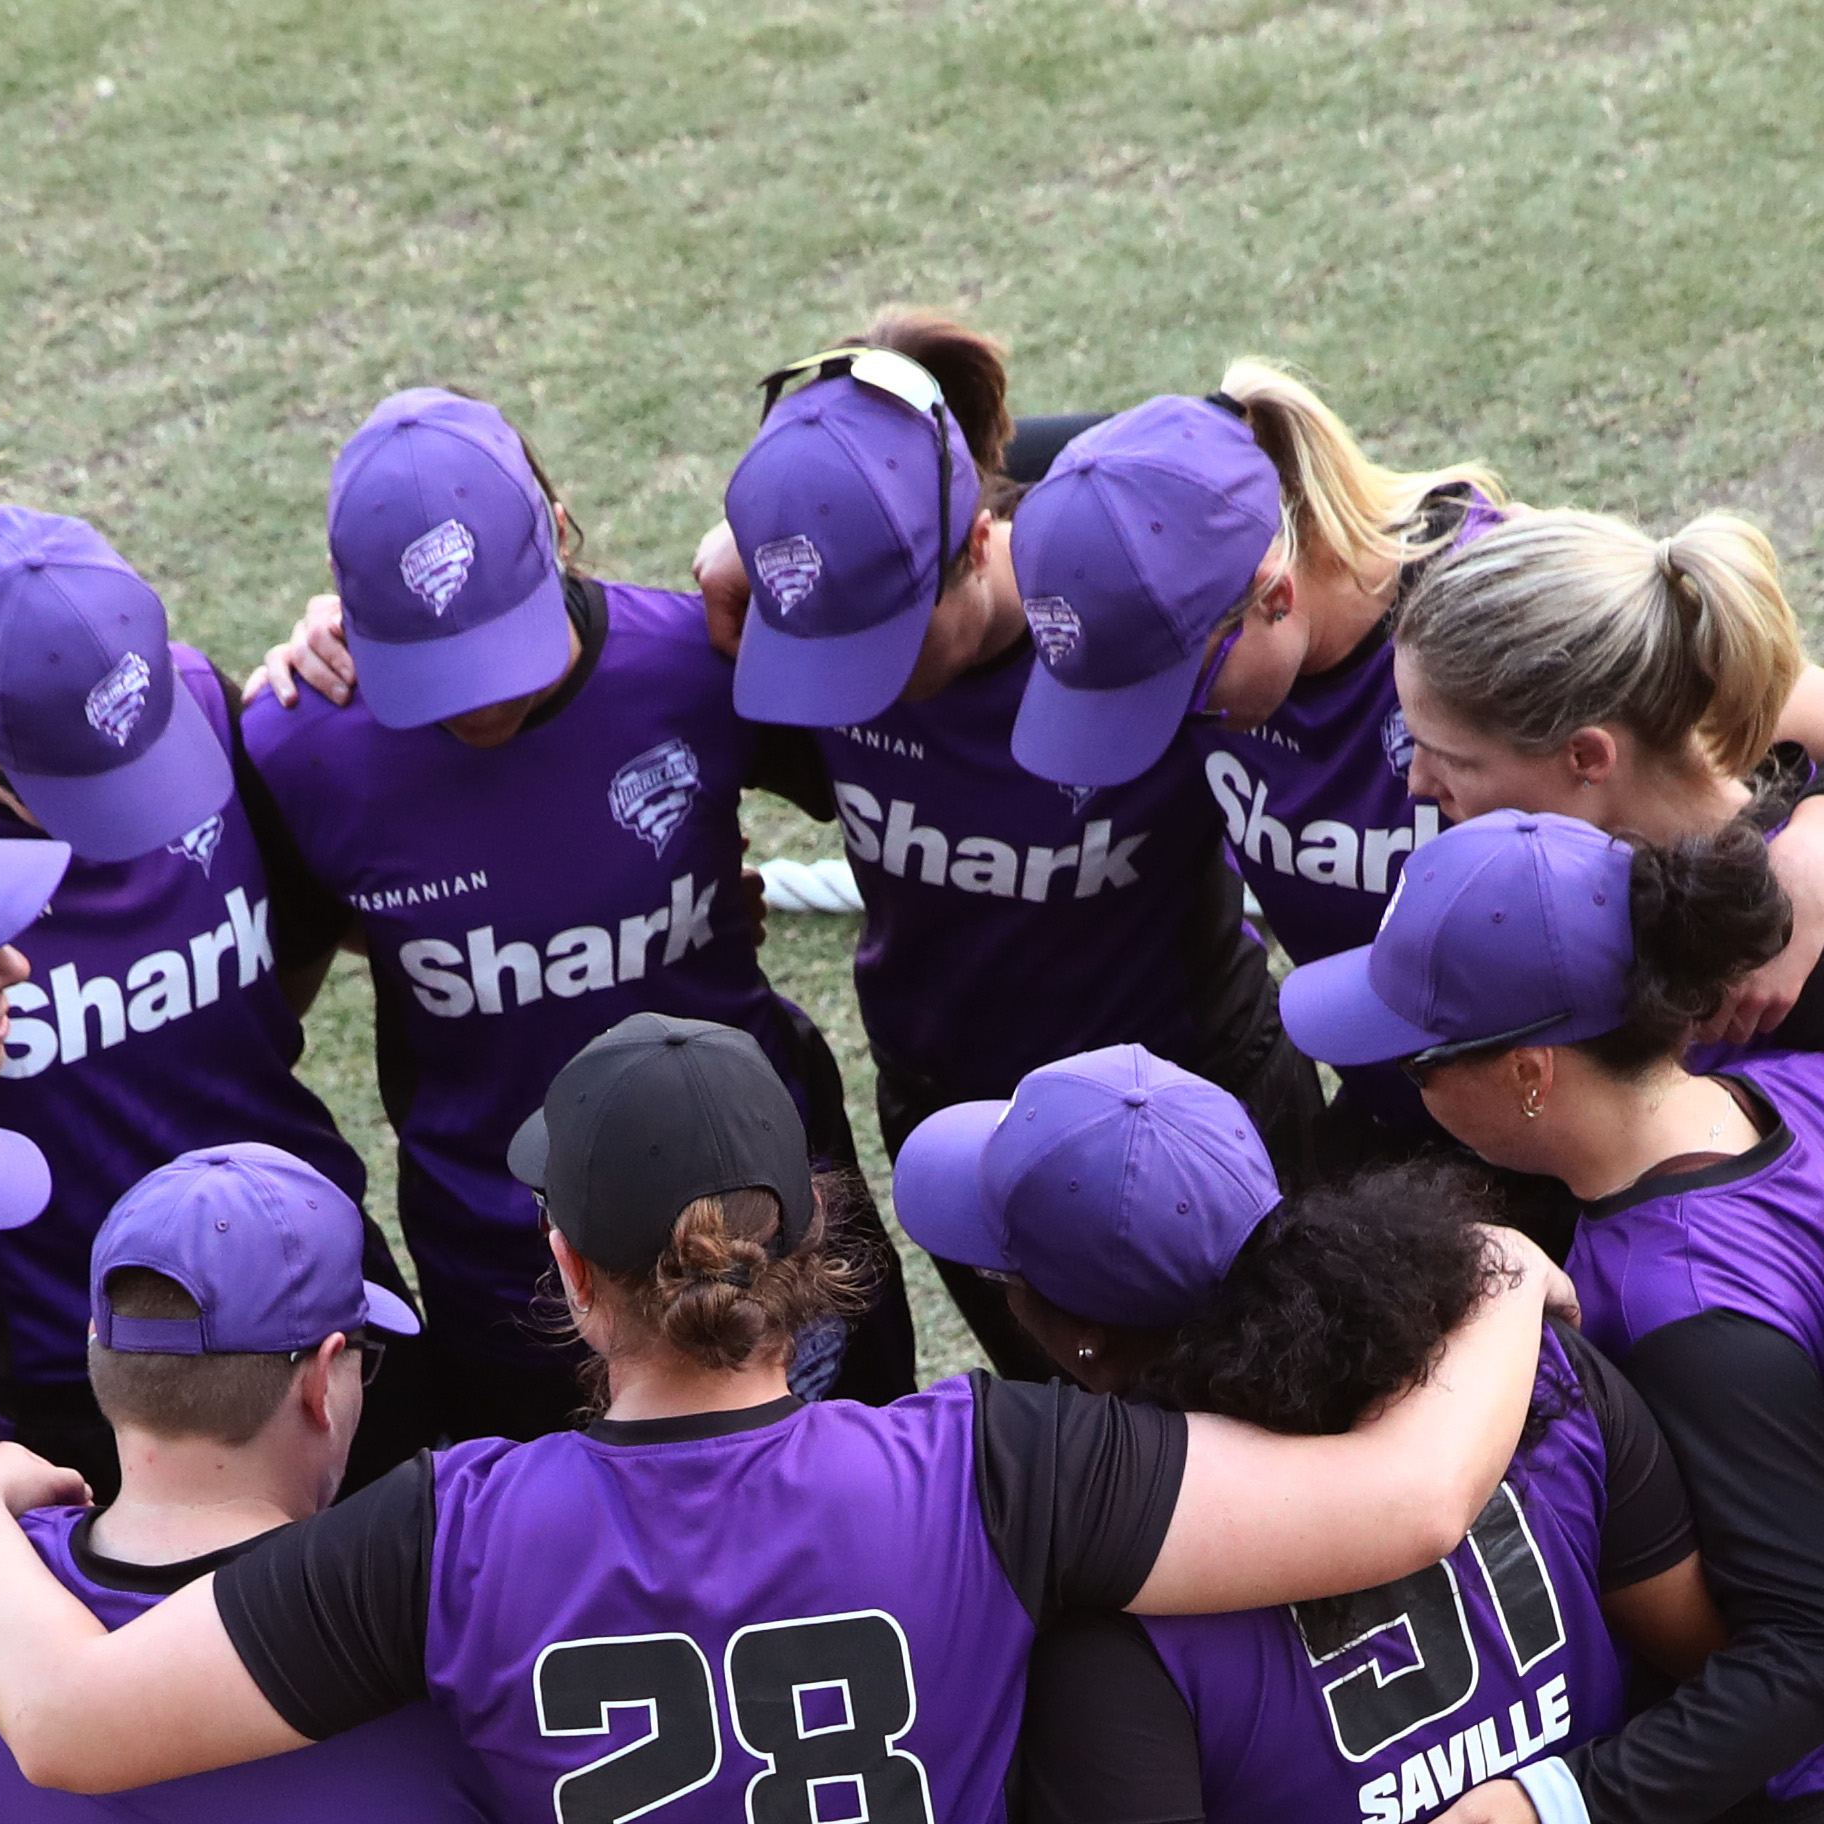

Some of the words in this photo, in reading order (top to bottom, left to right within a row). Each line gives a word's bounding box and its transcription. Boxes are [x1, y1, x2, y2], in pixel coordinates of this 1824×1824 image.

[349, 869, 489, 912] TASMANIAN
[834, 781, 1150, 904] Shark
[398, 870, 719, 1020] Shark
